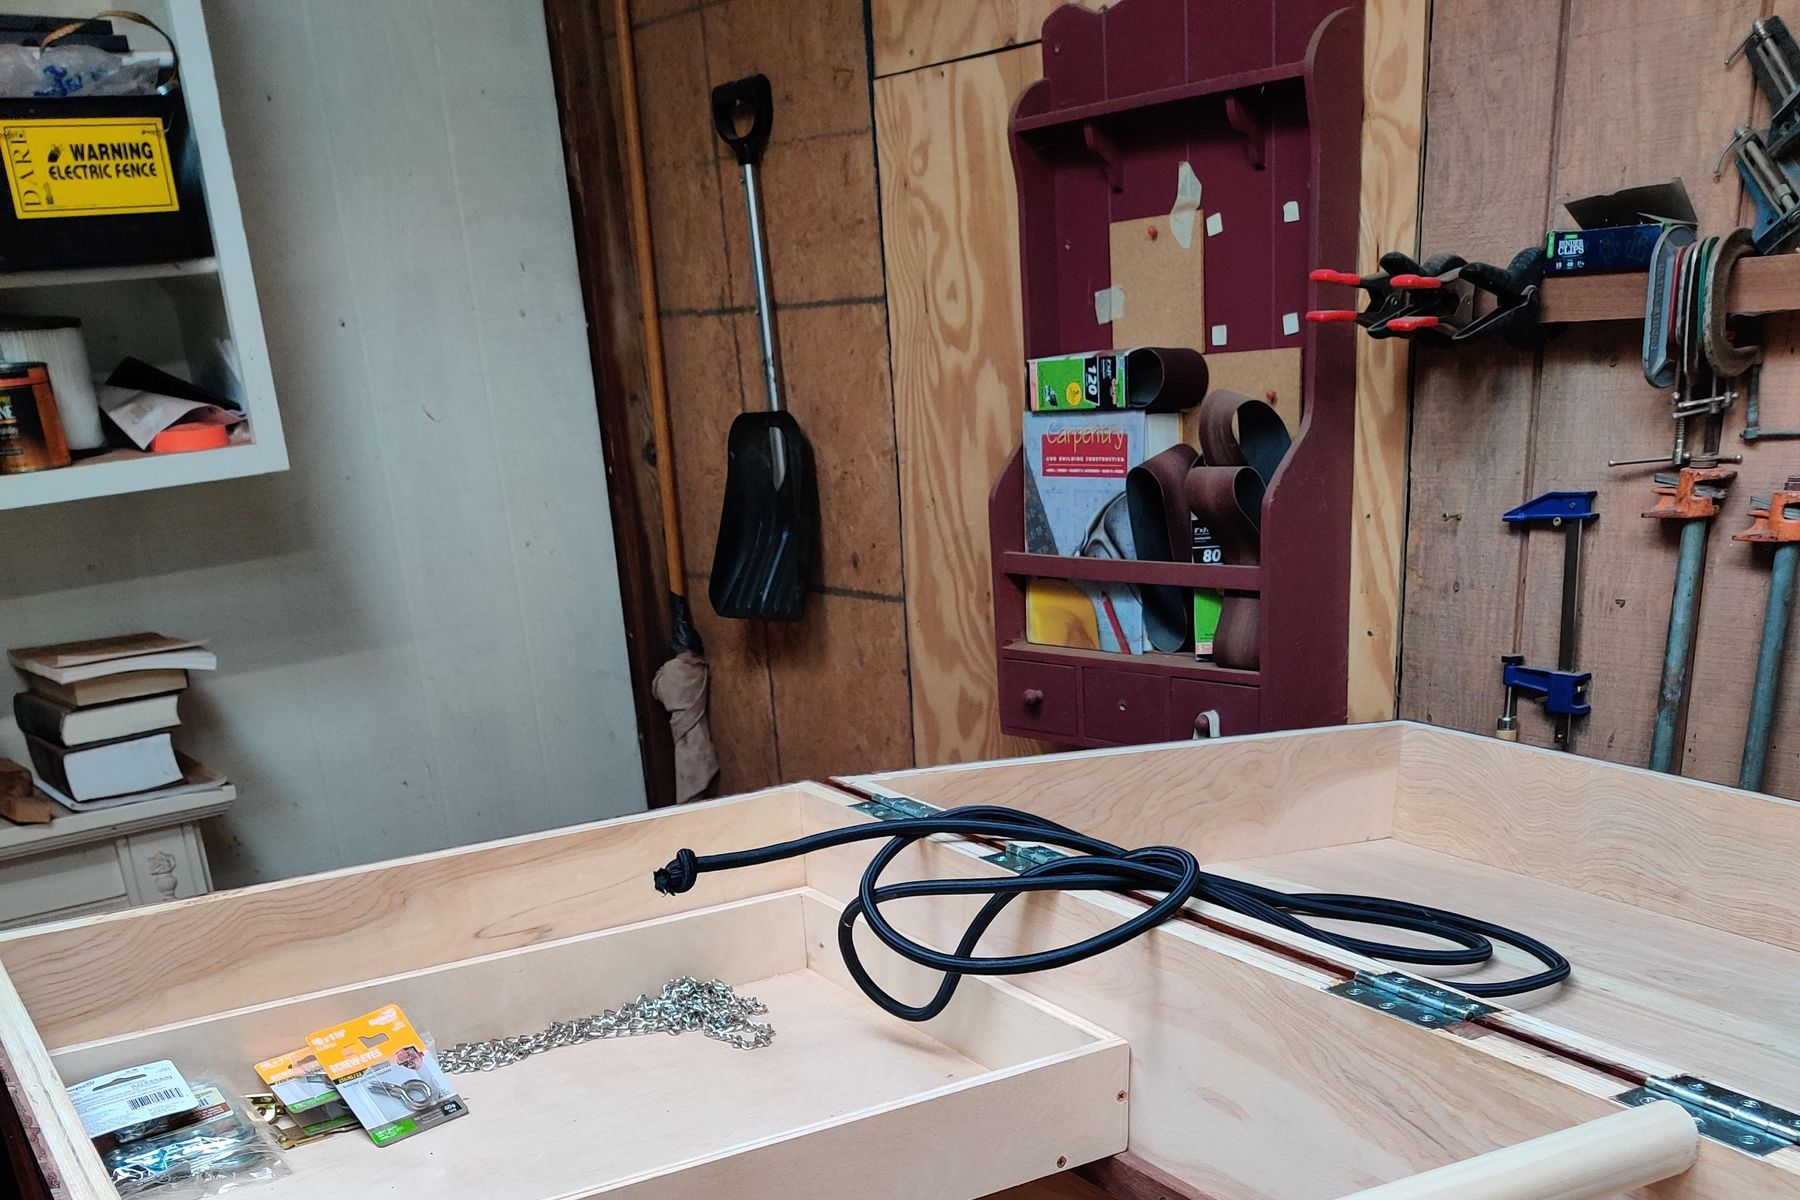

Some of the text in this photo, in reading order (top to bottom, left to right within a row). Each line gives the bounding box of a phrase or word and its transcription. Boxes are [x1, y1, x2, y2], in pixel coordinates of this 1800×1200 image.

[70, 142, 154, 162] WARNING
[10, 130, 41, 206] DARE
[48, 162, 158, 181] ELECTRIC FENCE
[1557, 245, 1585, 256] CLIPS
[1087, 365, 1098, 396] 120
[1046, 420, 1126, 453] Carpentry
[1202, 548, 1222, 563] 80
